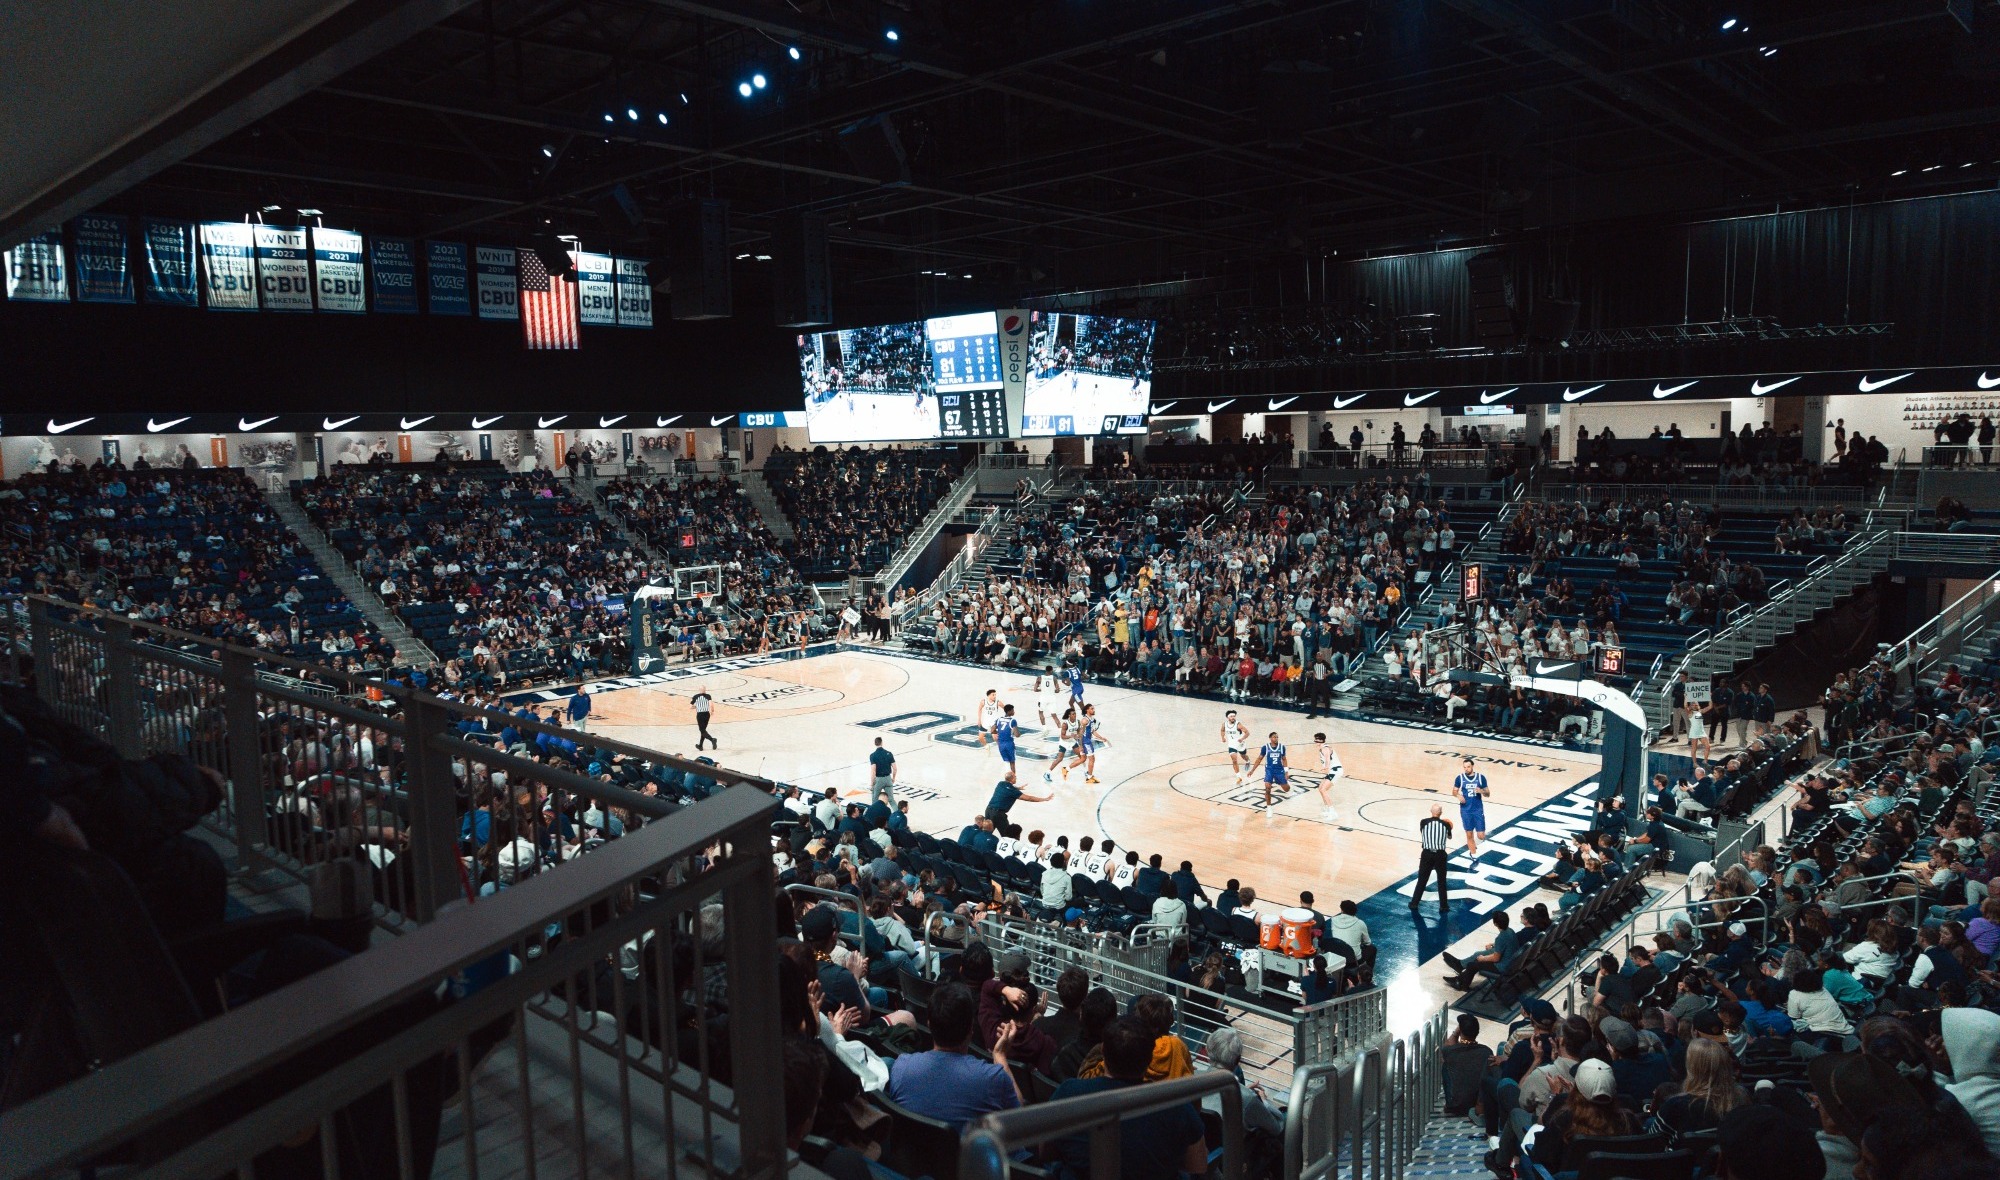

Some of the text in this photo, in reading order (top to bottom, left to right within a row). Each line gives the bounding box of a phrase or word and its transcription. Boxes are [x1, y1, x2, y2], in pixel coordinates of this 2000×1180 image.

[83, 218, 118, 230] 2024
[152, 224, 184, 236] 2024
[80, 231, 121, 240] WOMEN'S
[261, 233, 302, 245] WNIT
[77, 239, 126, 248] BASKETBA
[319, 237, 357, 249] WNIT
[380, 242, 405, 252] 2021
[272, 249, 295, 258] 2022
[434, 245, 458, 255] 2021
[328, 252, 349, 261] 2021
[430, 255, 461, 263] WOMEN'S
[479, 251, 512, 263] WNIT
[81, 254, 126, 272] WAC
[261, 263, 307, 272] WOMEN'S
[373, 258, 415, 267] BASKETBALL
[428, 262, 467, 270] BASKETBALL
[584, 260, 607, 270] CBI
[11, 263, 62, 281] CBU
[324, 264, 356, 272] WOMEN'S
[487, 266, 505, 274] 2019
[211, 273, 253, 291] CBU
[377, 272, 413, 286] WAC
[432, 274, 465, 289] WAC
[588, 273, 604, 281] 2019
[627, 276, 643, 284] 2022
[264, 275, 306, 293] CBU
[320, 278, 361, 296] CBU
[480, 280, 515, 288] WOMEN'S
[624, 288, 645, 296] MEN'S
[481, 290, 515, 305] CBU
[582, 295, 613, 310] CBU
[620, 297, 649, 312] CBU
[480, 307, 517, 315] BASKETBALL
[933, 319, 952, 330] 129
[935, 339, 955, 354] CBU
[940, 357, 955, 373] 81
[977, 356, 985, 364] 21
[1006, 340, 1022, 383] pepsi
[965, 375, 975, 383] 20
[942, 395, 960, 406] GCU
[982, 401, 990, 409] 10
[945, 410, 961, 425] 67
[982, 410, 990, 418] 13
[746, 413, 775, 426] CBU
[1028, 415, 1050, 429] CBU
[1058, 417, 1071, 432] 81
[1104, 417, 1118, 431] 67
[1124, 415, 1143, 427] GCU
[972, 428, 980, 436] 21
[985, 427, 992, 435] 11
[1466, 578, 1477, 597] 30
[642, 614, 652, 647] CBU
[1606, 650, 1622, 659] 1:29
[1603, 659, 1618, 671] 30
[1045, 680, 1050, 688] 0
[1000, 721, 1007, 731] 7
[1372, 717, 1564, 747] @CBULANCERS
[1272, 757, 1278, 765] 2
[1424, 749, 1567, 773] #LANCEUP
[998, 842, 1009, 852] 12
[1022, 850, 1028, 859] 4
[1069, 857, 1079, 868] 14
[1088, 863, 1099, 874] 42
[1116, 869, 1129, 879] 10
[1262, 925, 1270, 934] G
[1285, 926, 1296, 939] G
